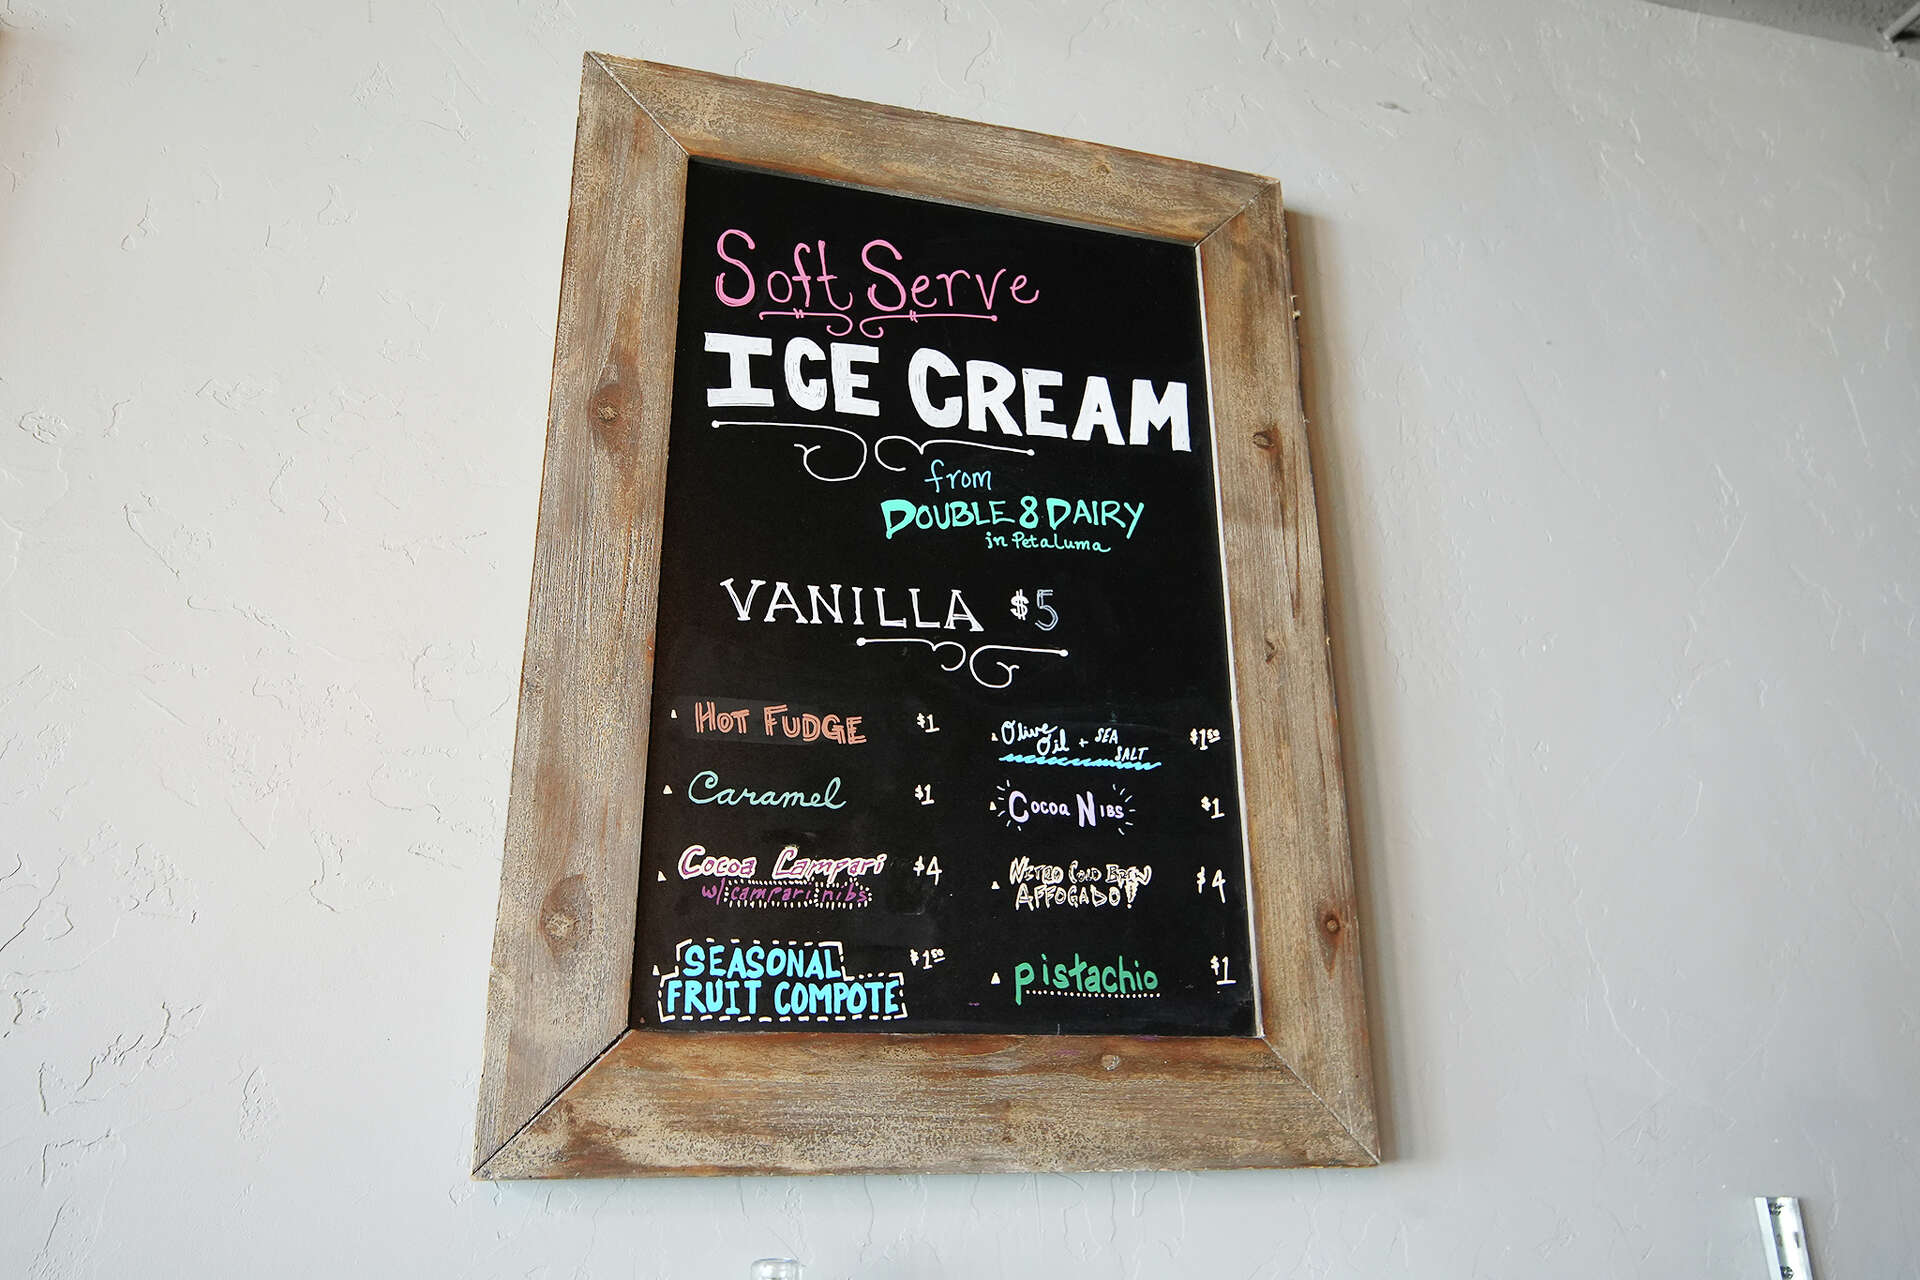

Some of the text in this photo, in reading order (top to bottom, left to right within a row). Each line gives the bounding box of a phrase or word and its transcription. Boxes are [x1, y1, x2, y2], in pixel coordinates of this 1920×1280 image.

[715, 229, 1040, 312] Soft Serve
[704, 332, 1192, 453] ICE CREAM
[924, 459, 992, 493] from
[881, 496, 1144, 539] DOUBLE 8 DAIRY
[985, 531, 1111, 553] in Petaluma
[720, 577, 1059, 632] VANILLA $5
[694, 701, 867, 745] HOT FUDGE
[916, 712, 940, 733] $1
[1001, 720, 1058, 745] Olive
[1095, 728, 1119, 745] SEA
[1115, 746, 1149, 762] SALT
[687, 770, 847, 810] Caramel
[914, 784, 935, 805] $1
[1201, 796, 1225, 819] $1
[678, 844, 757, 879] Cocoa
[913, 856, 942, 886] $4
[821, 883, 868, 903] nibs
[1196, 866, 1226, 904] $4
[682, 945, 842, 980] SEASONAL
[1014, 953, 1159, 1006] pistachio
[1210, 955, 1237, 985] $1
[666, 978, 900, 1016] FRUIT COMPOTE
